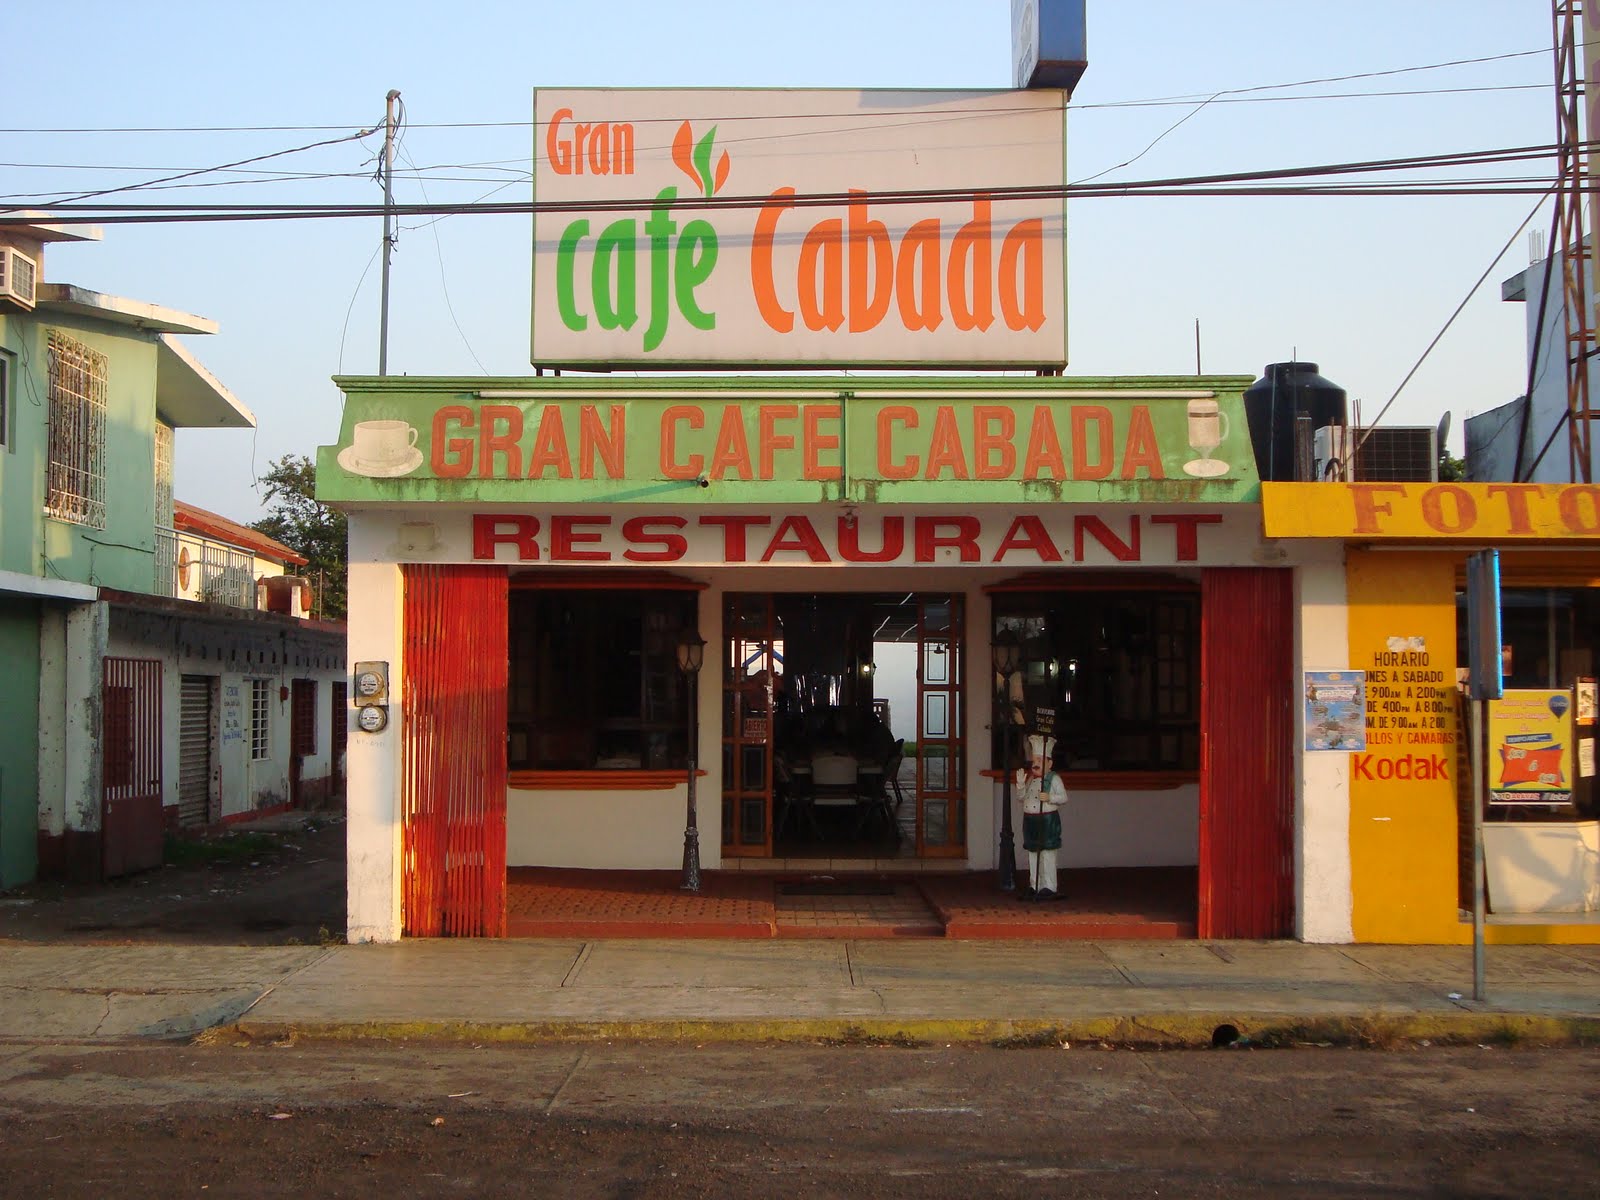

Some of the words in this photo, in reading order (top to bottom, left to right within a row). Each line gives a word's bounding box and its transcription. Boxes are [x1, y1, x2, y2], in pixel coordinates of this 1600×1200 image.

[546, 108, 634, 175] Gran
[750, 186, 1047, 334] Cabada
[430, 404, 625, 480] GRAN
[659, 404, 842, 481] CAFE
[876, 404, 1165, 481] CABADA
[471, 513, 1223, 563] RESTAURANT
[1374, 651, 1430, 667] HORARIO
[1364, 670, 1387, 682] UNES
[1392, 670, 1399, 682] A
[1403, 670, 1444, 683] SABADO
[1406, 686, 1413, 698] A
[1367, 700, 1378, 713] DE
[1364, 732, 1393, 745] OLLOS
[1396, 732, 1404, 744] Y
[1407, 732, 1455, 745] CAMARAS
[1353, 753, 1449, 781] Kodak
